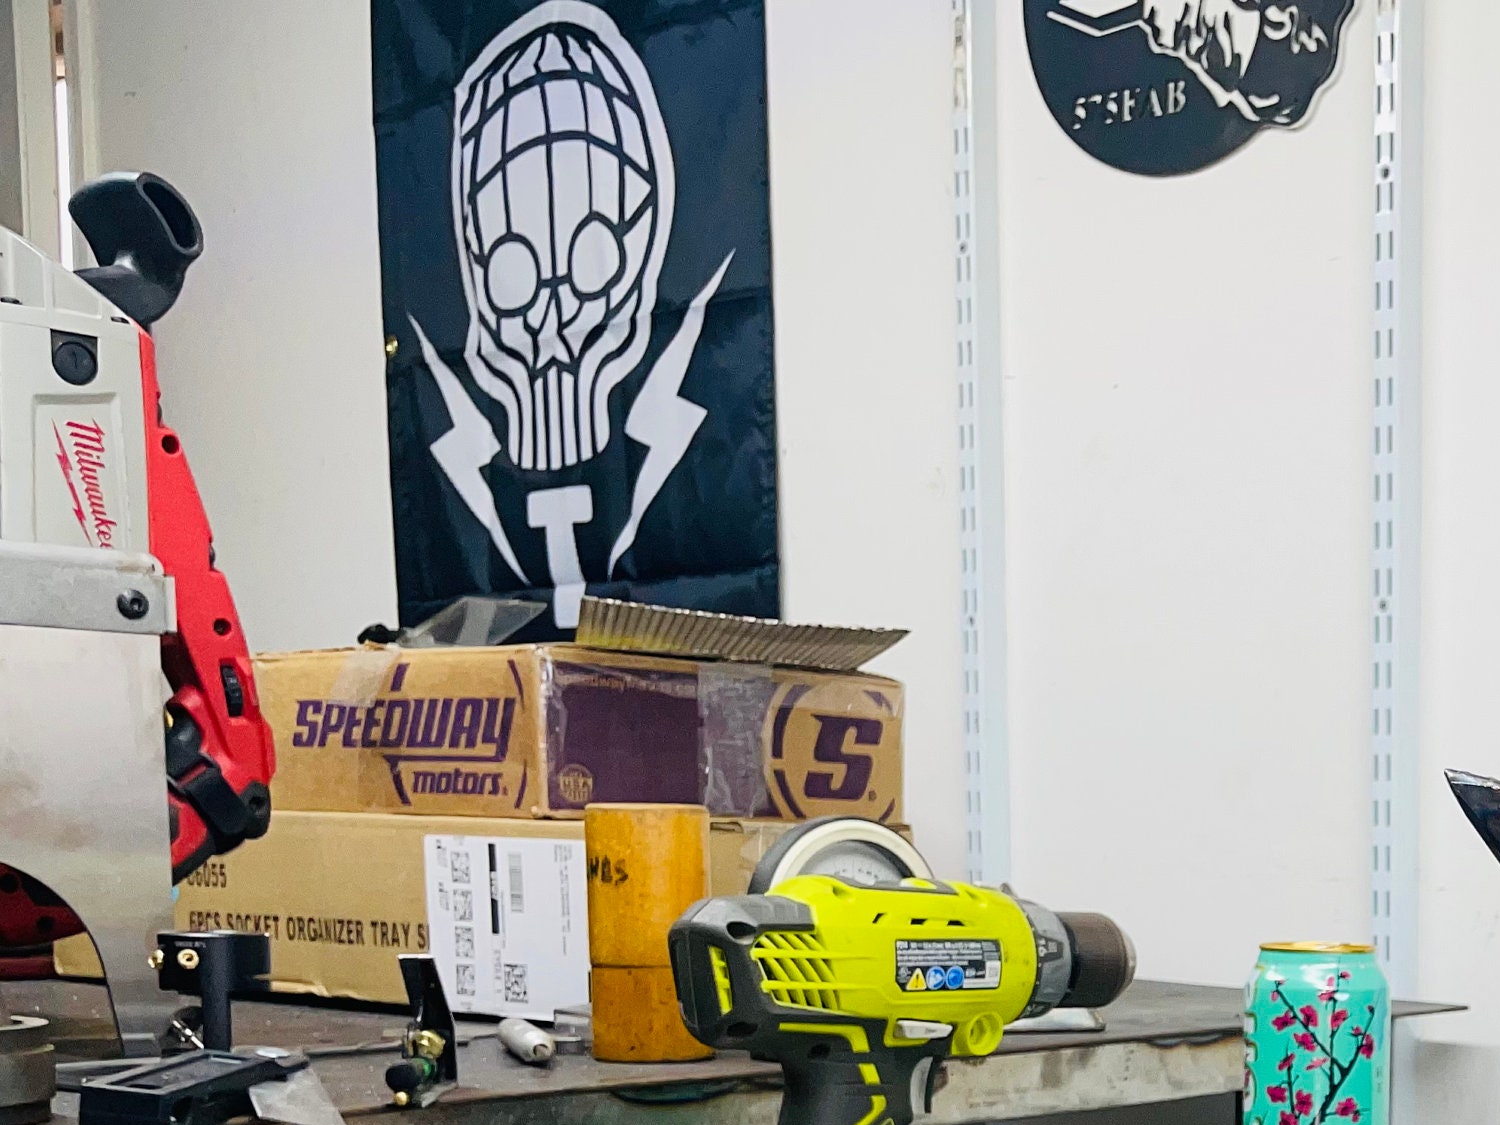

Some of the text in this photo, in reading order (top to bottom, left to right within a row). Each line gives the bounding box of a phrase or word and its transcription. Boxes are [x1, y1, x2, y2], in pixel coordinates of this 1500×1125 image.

[292, 697, 516, 762] SPEEDWAY
[412, 767, 504, 796] motors
[803, 713, 883, 801] S
[286, 916, 366, 946] ORGANIZER
[371, 921, 411, 949] TRAY
[417, 923, 431, 950] S
